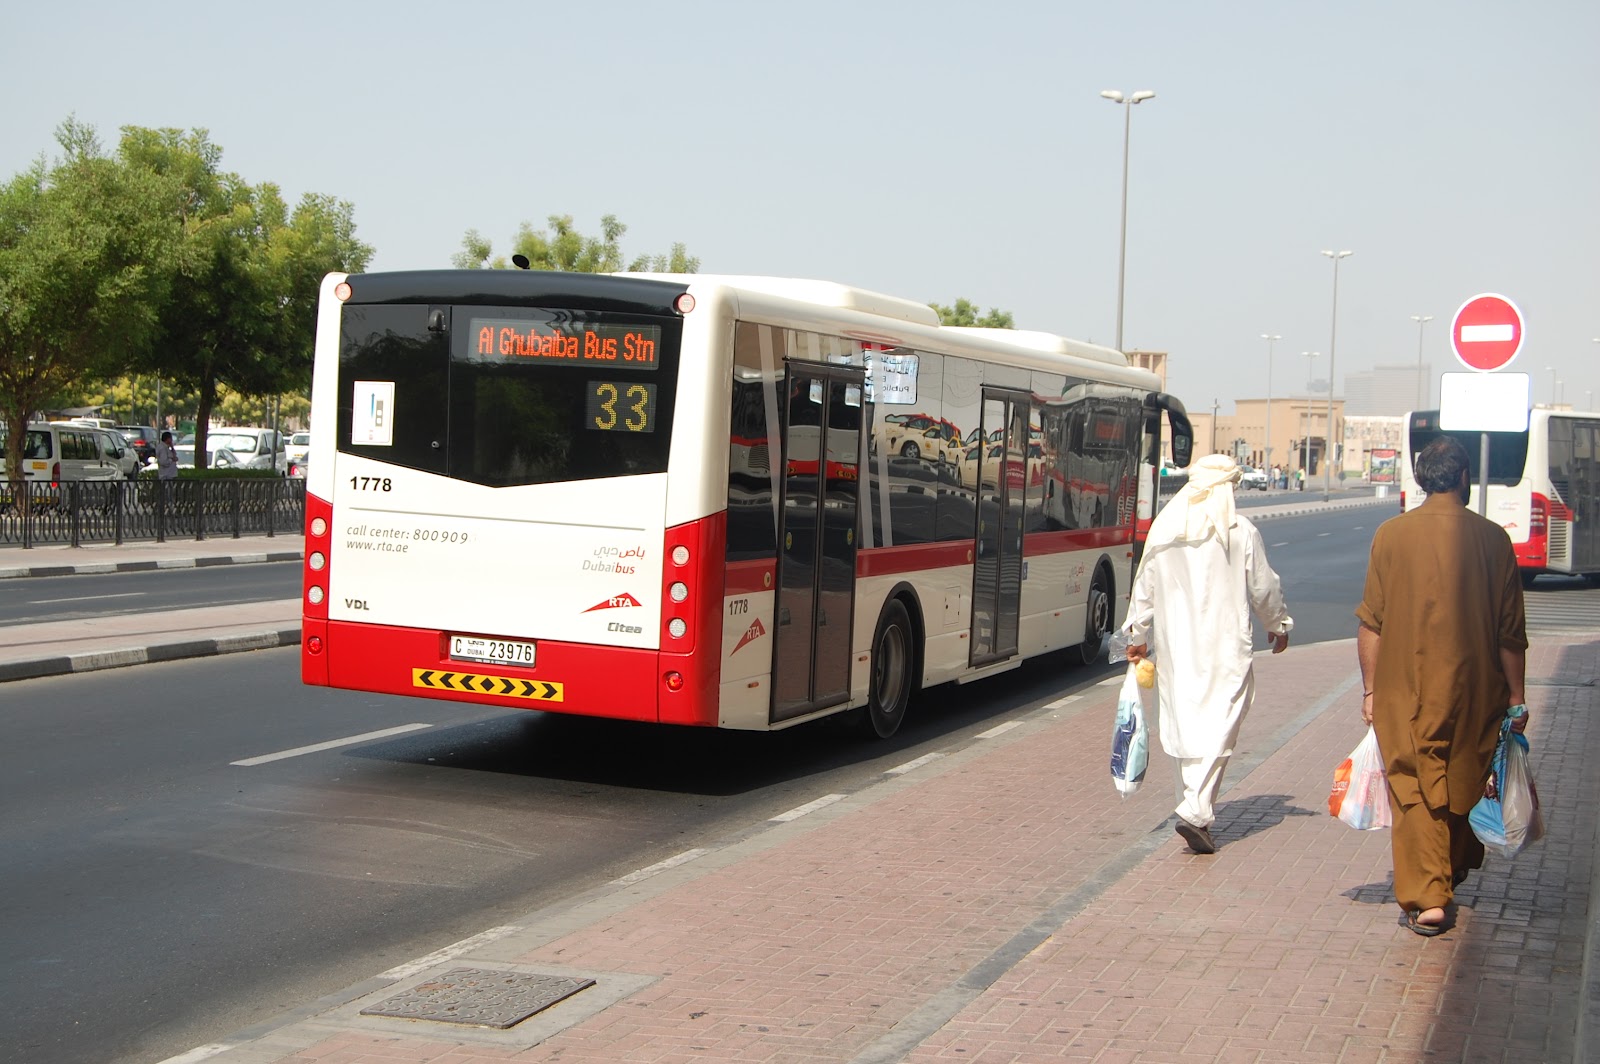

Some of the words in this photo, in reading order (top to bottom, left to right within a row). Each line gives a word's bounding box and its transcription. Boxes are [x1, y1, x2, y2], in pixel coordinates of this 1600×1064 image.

[479, 326, 495, 354] Al
[499, 327, 579, 358] Ghubaiba
[584, 331, 617, 360] Bus
[623, 332, 655, 362] Stn
[595, 383, 648, 432] 33
[350, 476, 392, 492] 1778
[346, 525, 367, 537] call
[369, 528, 410, 540] center:
[412, 528, 469, 545] 800909
[346, 540, 409, 553] www.rta.ae
[344, 598, 370, 611] VDL
[608, 597, 633, 607] RTA
[729, 599, 748, 616] 1778
[607, 622, 643, 634] Citea
[746, 626, 761, 640] RTA
[455, 638, 462, 654] C
[467, 648, 485, 656] DUBAI
[489, 641, 532, 661] 23976
